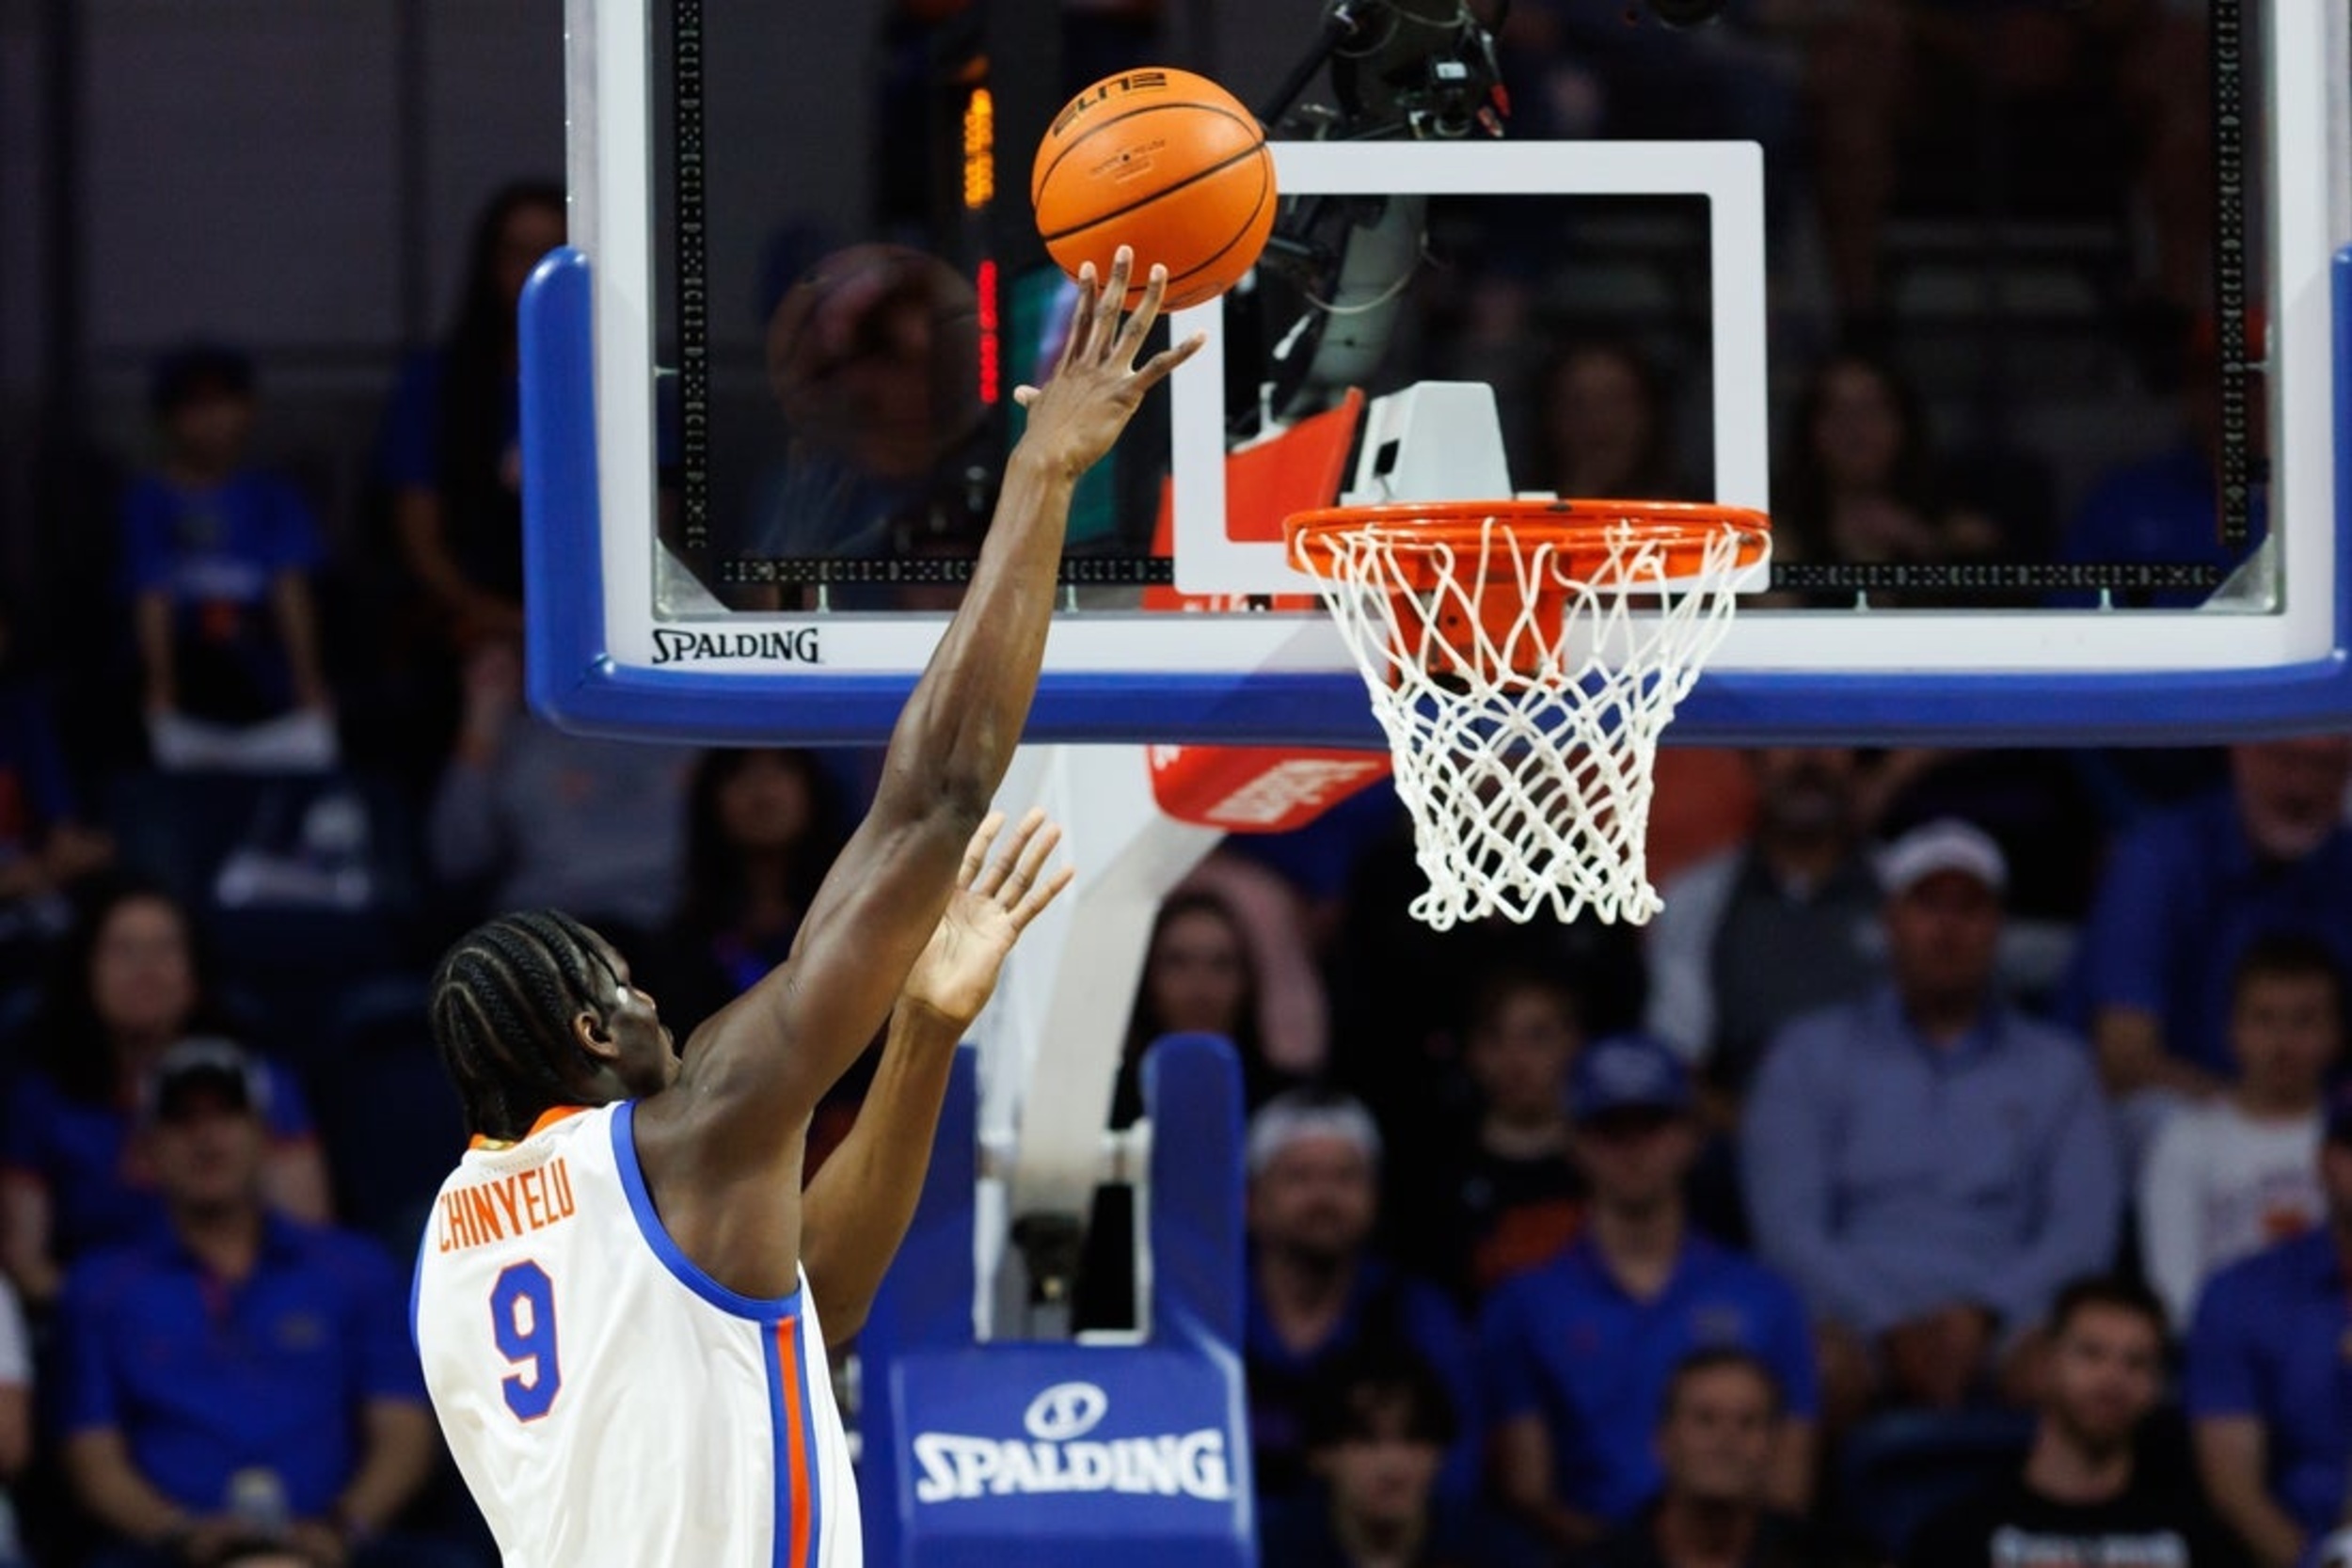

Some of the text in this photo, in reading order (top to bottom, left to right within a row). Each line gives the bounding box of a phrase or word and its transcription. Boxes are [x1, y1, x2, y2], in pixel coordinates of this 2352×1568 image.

[1053, 72, 1167, 136] ELITE
[652, 627, 821, 664] SPALDING
[439, 1158, 575, 1253] CHINYELU
[489, 1259, 562, 1423] 9
[914, 1430, 1231, 1503] SPALDING
